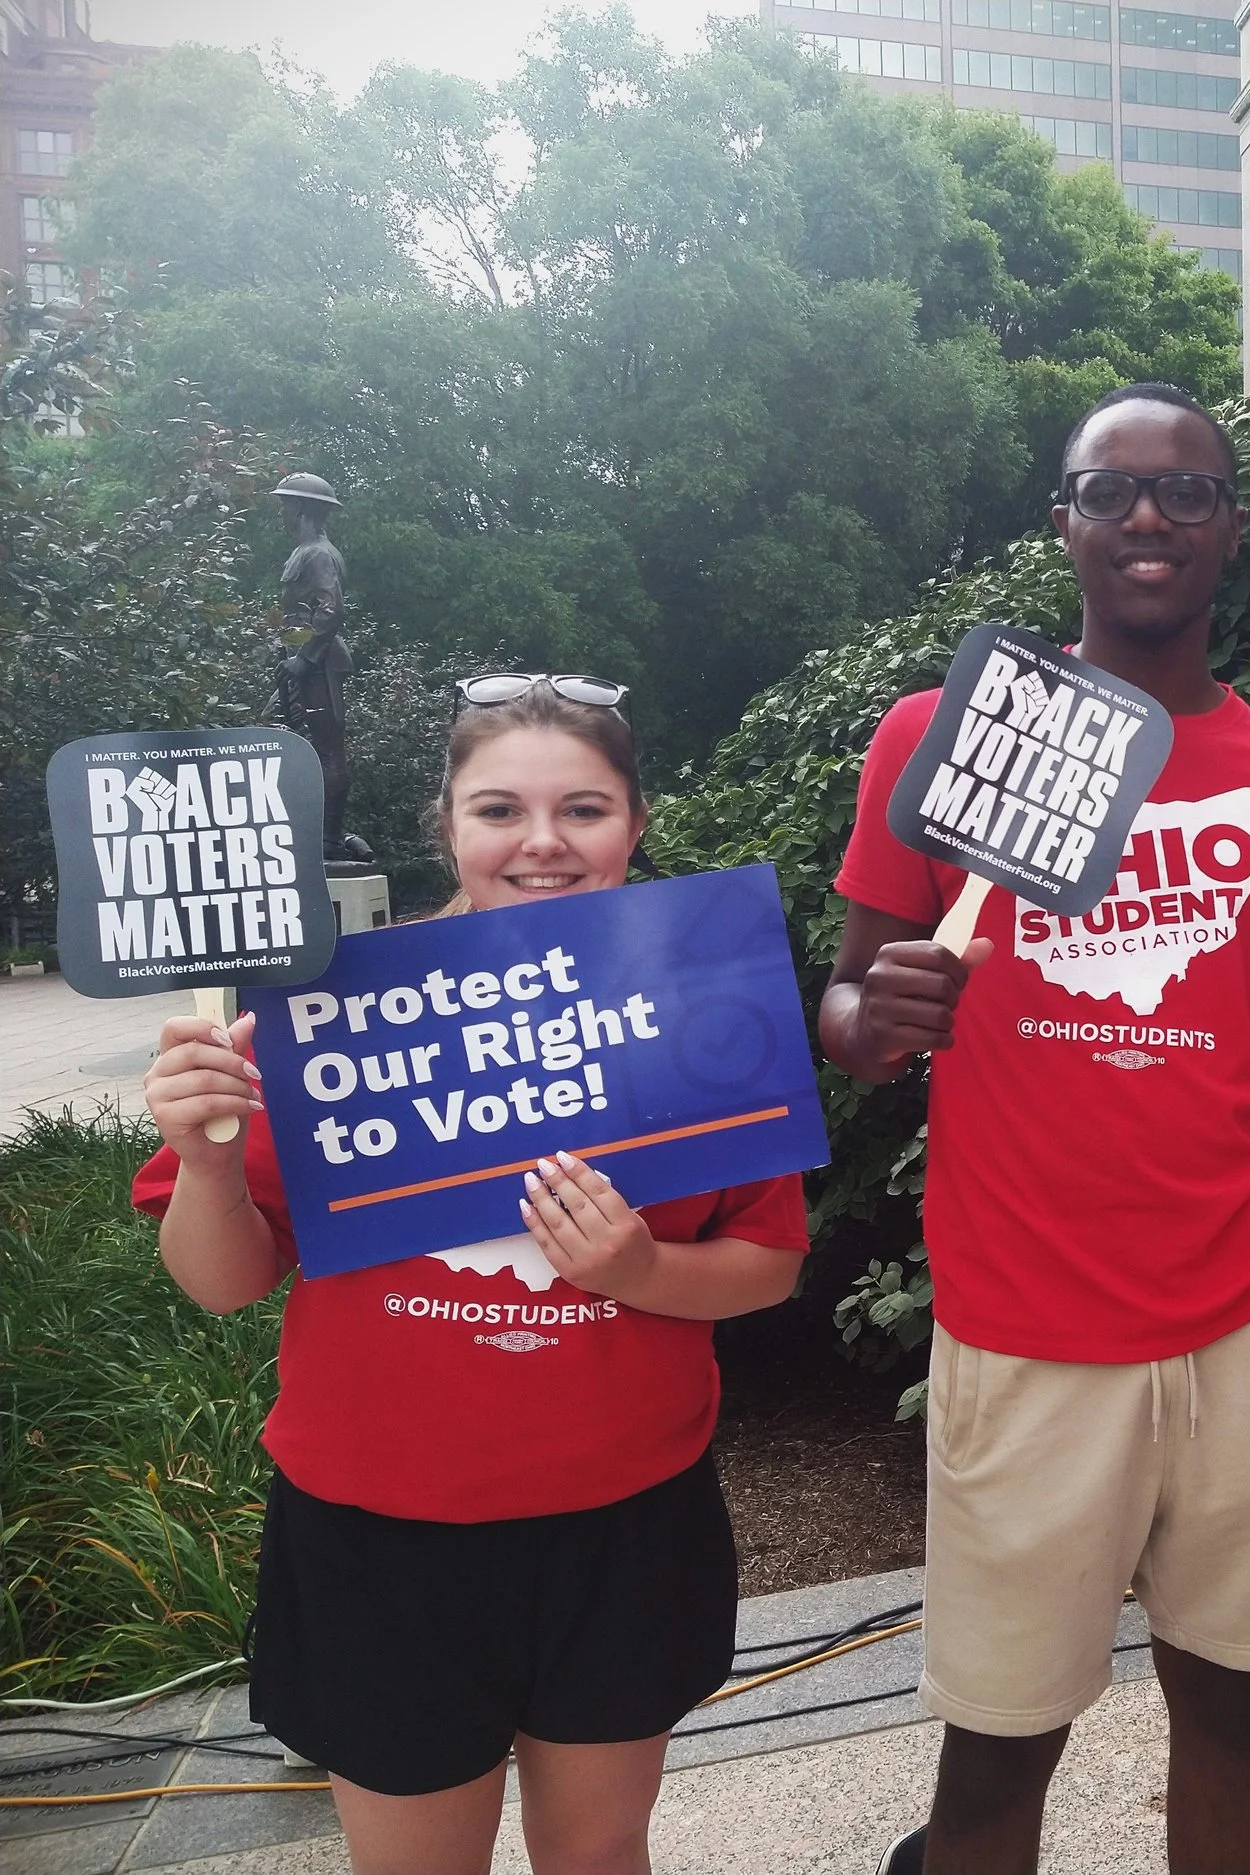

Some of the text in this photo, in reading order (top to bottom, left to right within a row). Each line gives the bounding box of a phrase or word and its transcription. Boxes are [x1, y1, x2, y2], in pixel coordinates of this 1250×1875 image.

[996, 636, 1149, 717] I MATTER. YOU MATTER. WE MATTER.
[85, 742, 283, 762] I MATTER. YOU MATTER. WE MATTER.
[950, 707, 1120, 829] VOTERS
[918, 762, 1096, 884] MATTER
[924, 825, 1061, 894] BlackVotersMatterFund.org
[93, 824, 296, 897] VOTERS
[97, 889, 304, 962] MATTER
[1020, 888, 1243, 944] STUDENT
[1049, 926, 1230, 963] ASSOCIATION
[119, 955, 291, 978] BlackVotersMatterFund.org
[287, 946, 580, 1044] Protect
[303, 992, 660, 1102] Our Right
[1017, 1017, 1216, 1051] @OHIOSTUDENTS
[313, 1064, 608, 1165] to Vote!
[384, 1293, 618, 1325] @OHIOSTUDENTS
